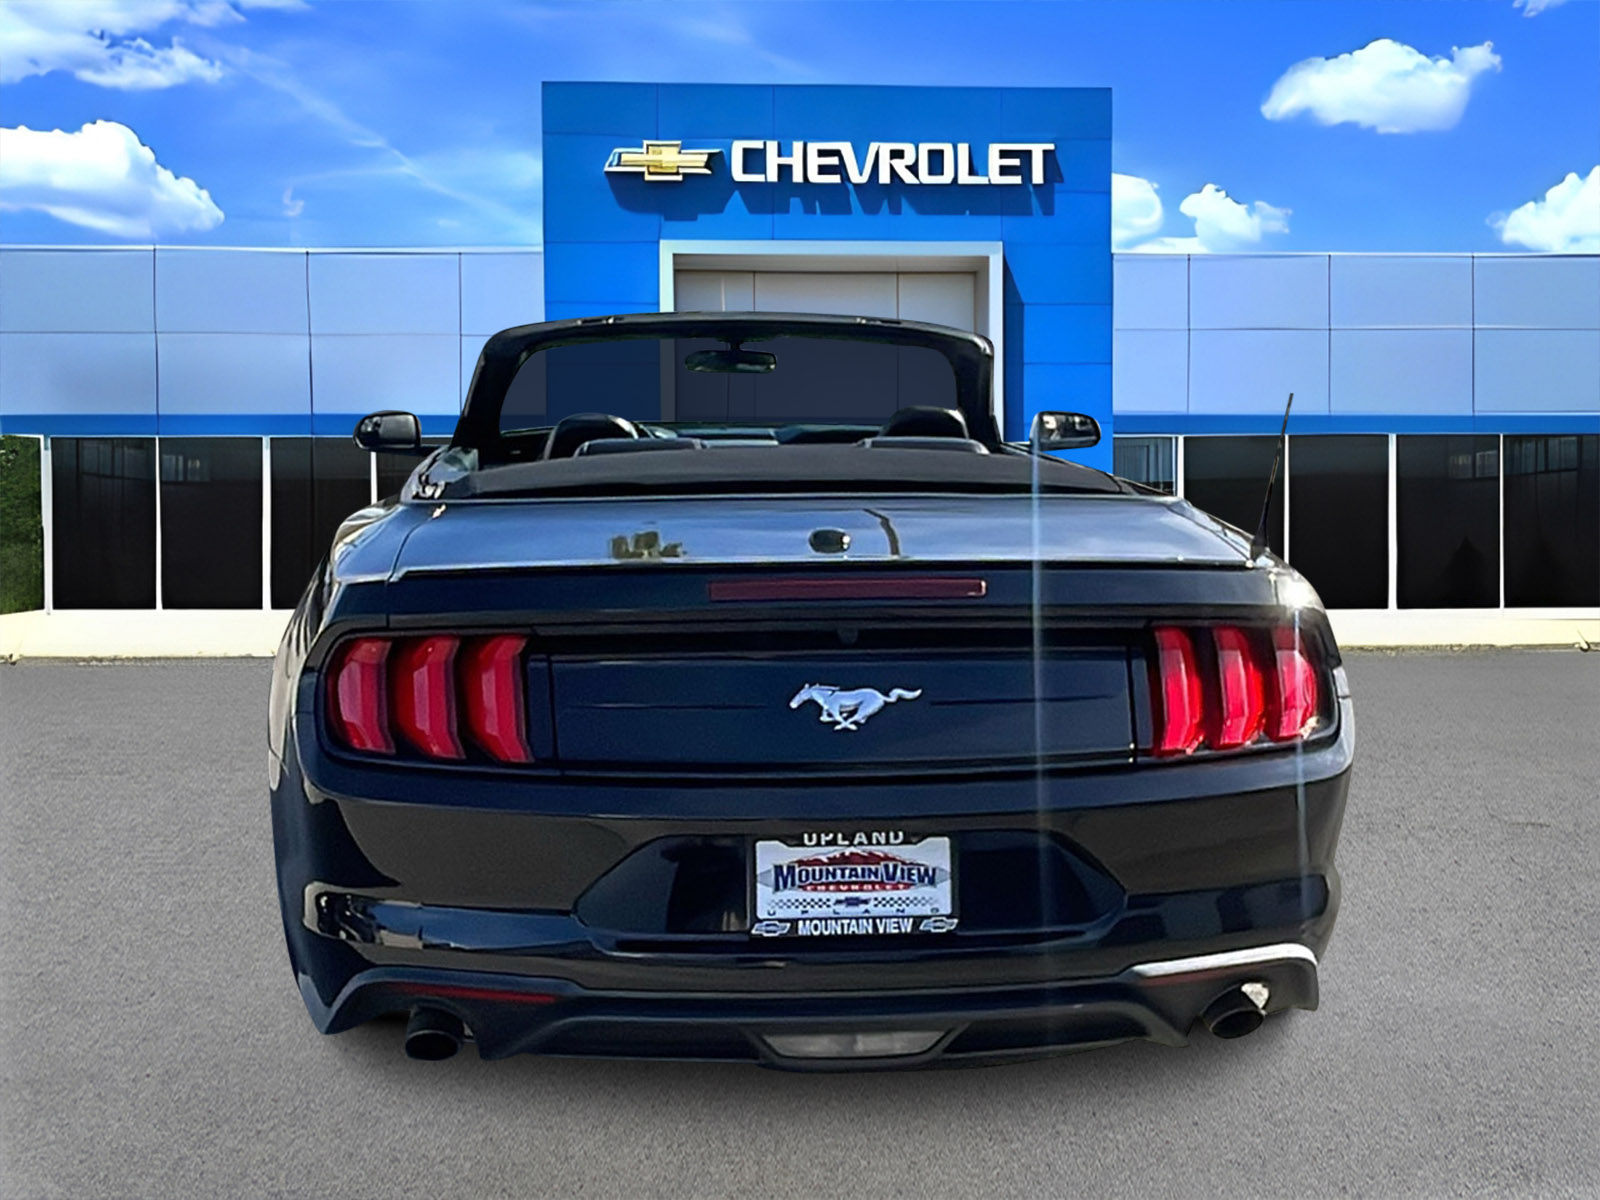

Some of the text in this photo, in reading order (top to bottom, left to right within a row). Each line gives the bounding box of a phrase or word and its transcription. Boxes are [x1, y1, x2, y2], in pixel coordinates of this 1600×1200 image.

[731, 140, 1055, 185] CHEVROLET
[803, 831, 904, 846] UPLAND
[798, 918, 914, 936] MOUNTAIN VIEW
